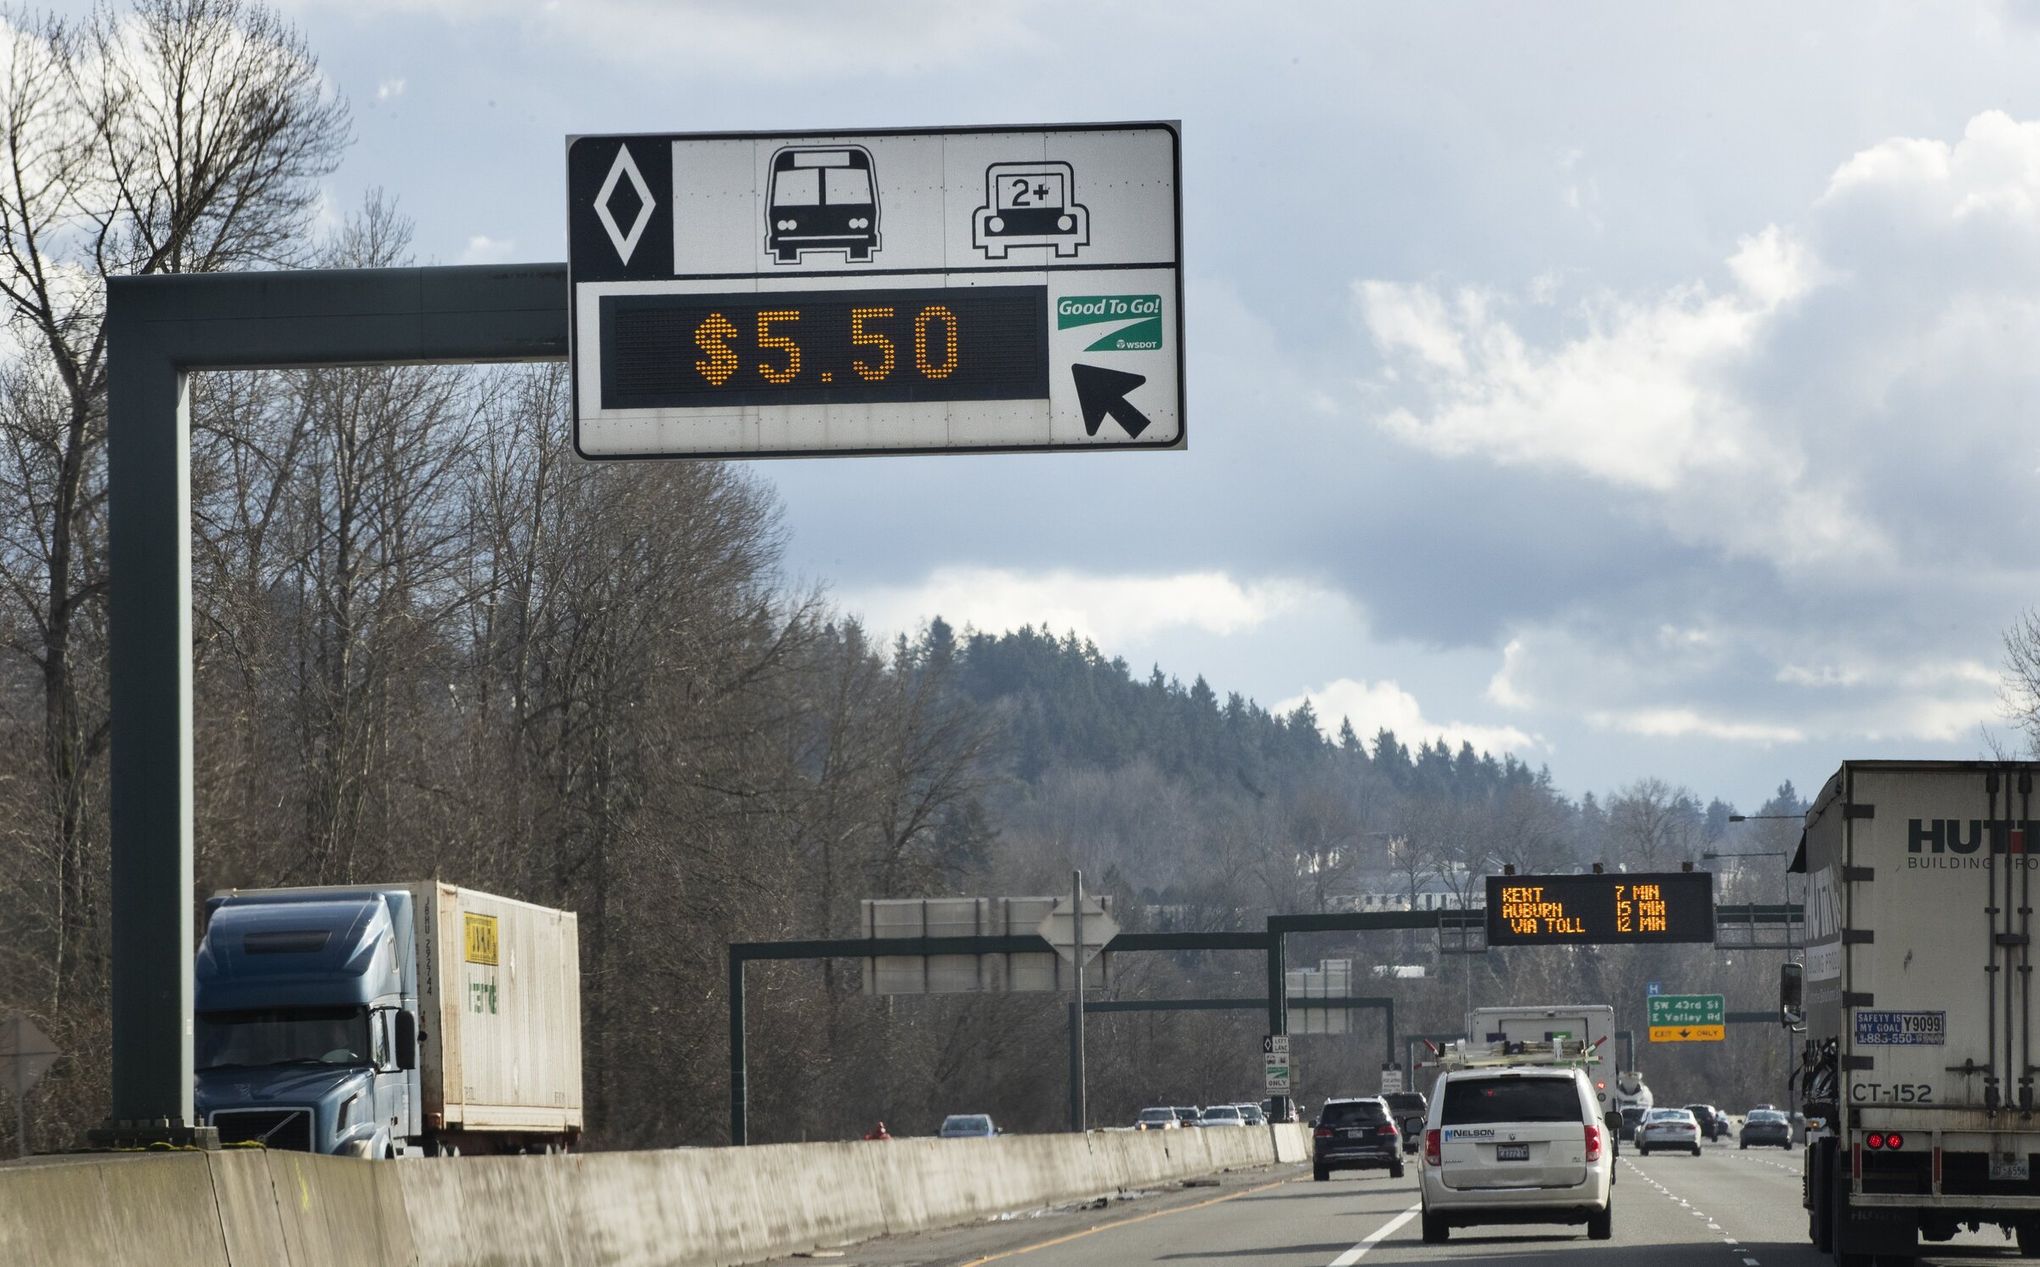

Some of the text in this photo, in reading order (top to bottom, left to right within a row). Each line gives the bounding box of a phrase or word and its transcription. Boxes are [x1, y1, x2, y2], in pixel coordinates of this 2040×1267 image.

[1011, 178, 1049, 207] 2+
[1059, 298, 1160, 315] Good To Go!
[695, 305, 958, 386] $5.50
[1126, 341, 1157, 349] WSDOT
[1908, 857, 1992, 869] BUILDING
[1502, 885, 1660, 903] KENT 7 MIN
[1502, 901, 1666, 918] AUBURN 15 MIN
[1510, 916, 1666, 933] VIA TOLL 12 MIN
[1649, 984, 1658, 993] H
[1653, 1000, 1719, 1010] SW 43rd St
[1652, 1012, 1720, 1023] E Valley Rd
[1858, 1014, 1900, 1022] SAFETY IS
[1903, 1016, 1941, 1032] Y9099
[1860, 1023, 1900, 1032] MY GOAL
[1852, 1083, 1933, 1102] CT-152
